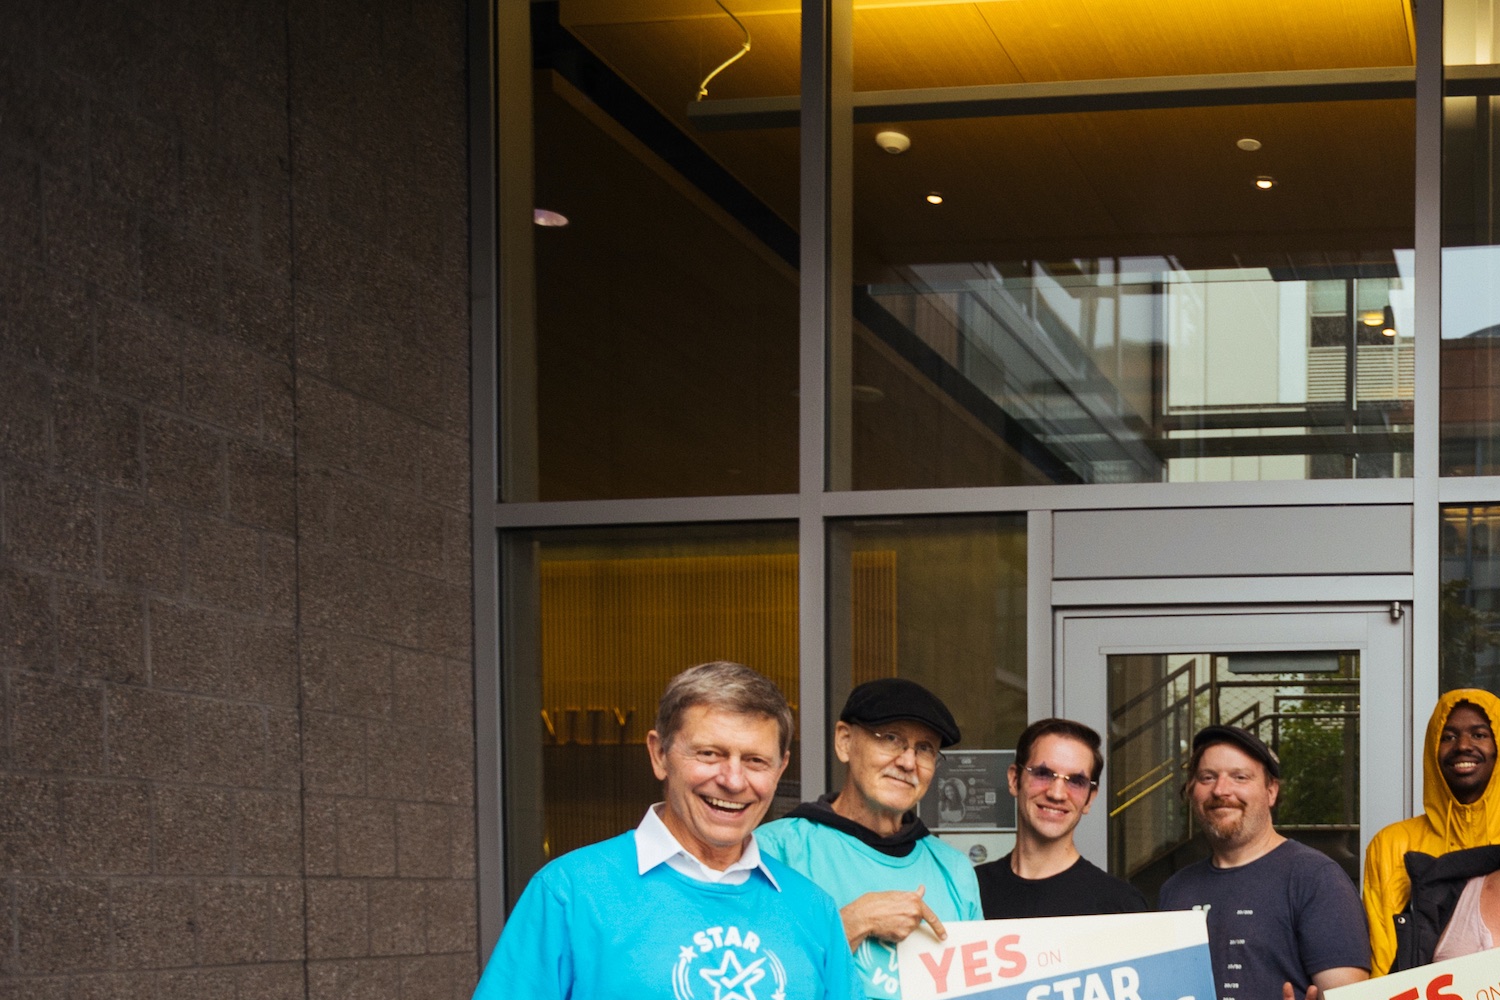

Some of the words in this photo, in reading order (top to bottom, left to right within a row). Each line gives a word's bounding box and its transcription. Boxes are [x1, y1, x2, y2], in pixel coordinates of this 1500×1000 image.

[693, 926, 760, 953] STAR
[919, 934, 1027, 993] YES
[1038, 950, 1061, 967] ON
